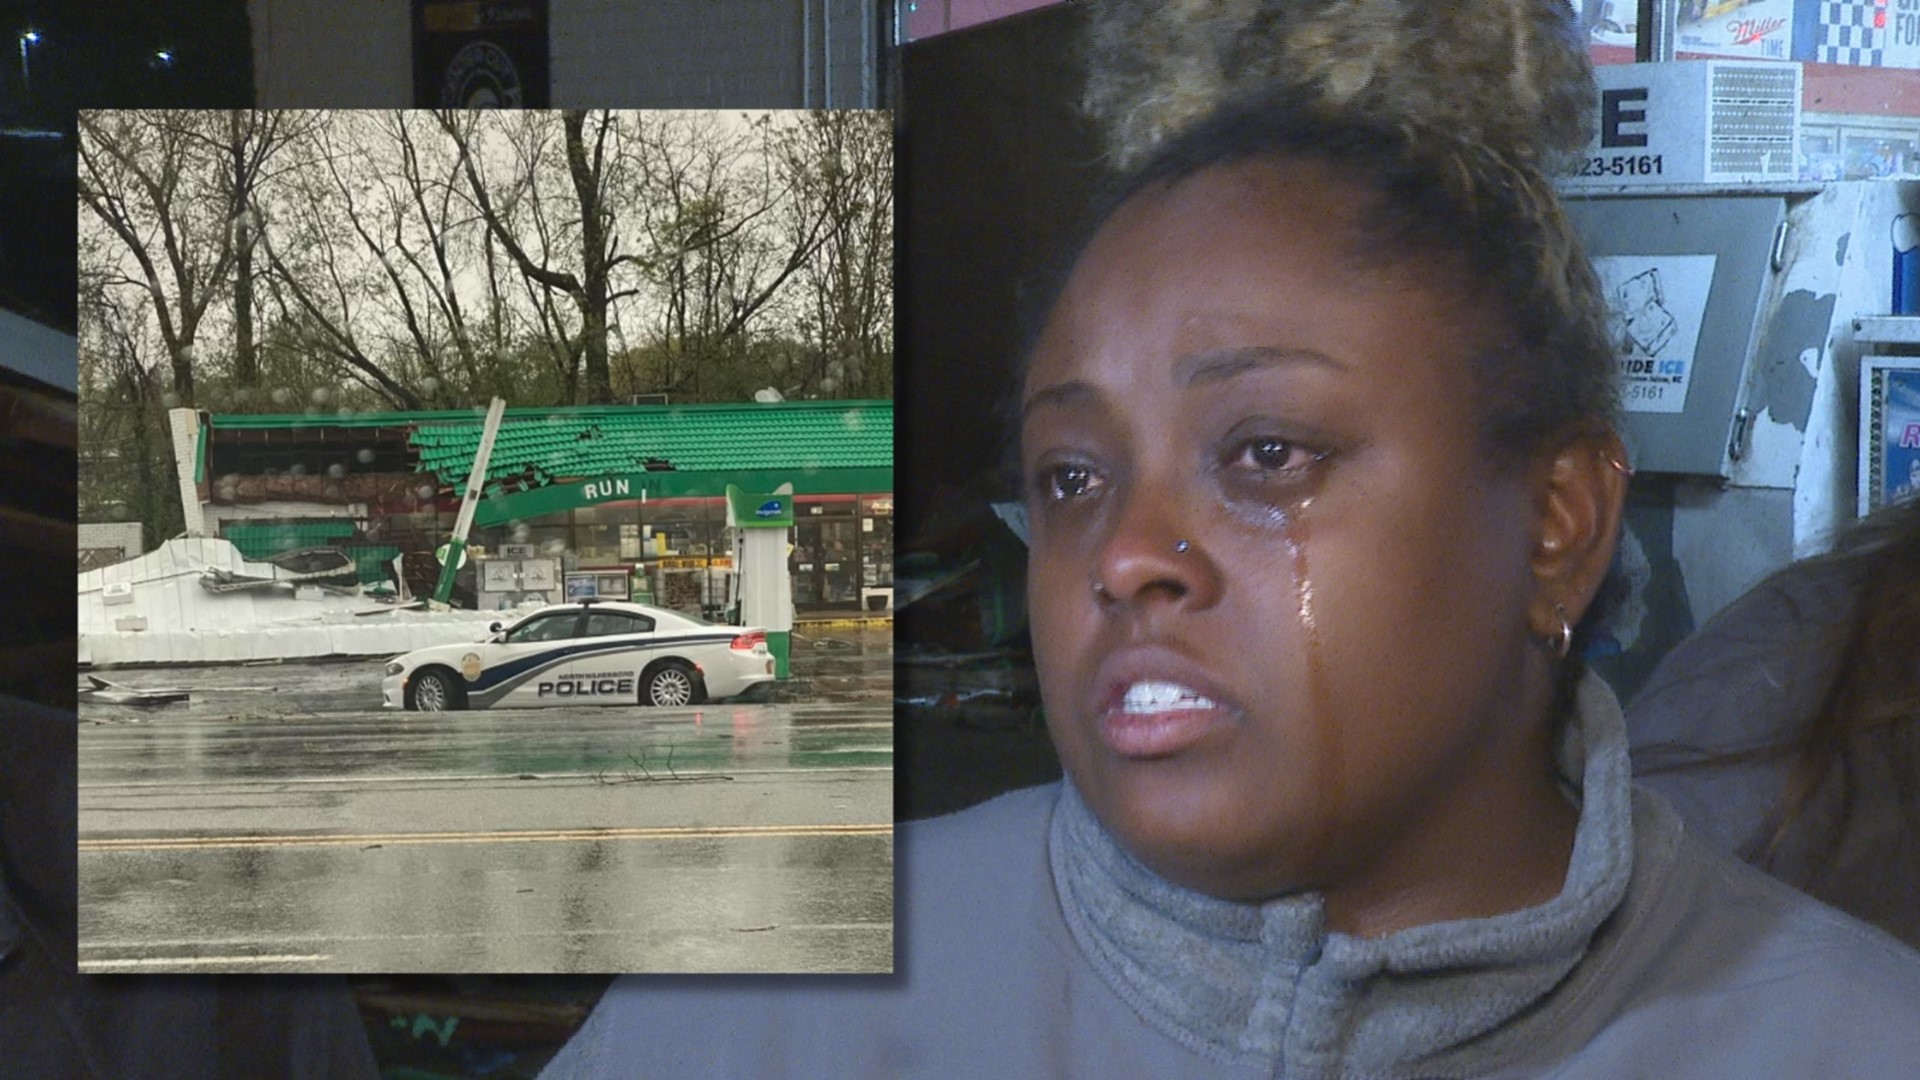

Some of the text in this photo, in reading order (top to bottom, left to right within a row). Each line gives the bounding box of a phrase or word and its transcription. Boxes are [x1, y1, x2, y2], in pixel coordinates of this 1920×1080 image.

[1726, 17, 1787, 44] Miller
[1760, 38, 1784, 58] TIME
[1658, 359, 1685, 374] ICE
[584, 479, 630, 500] RUN
[538, 678, 635, 698] POLICE
